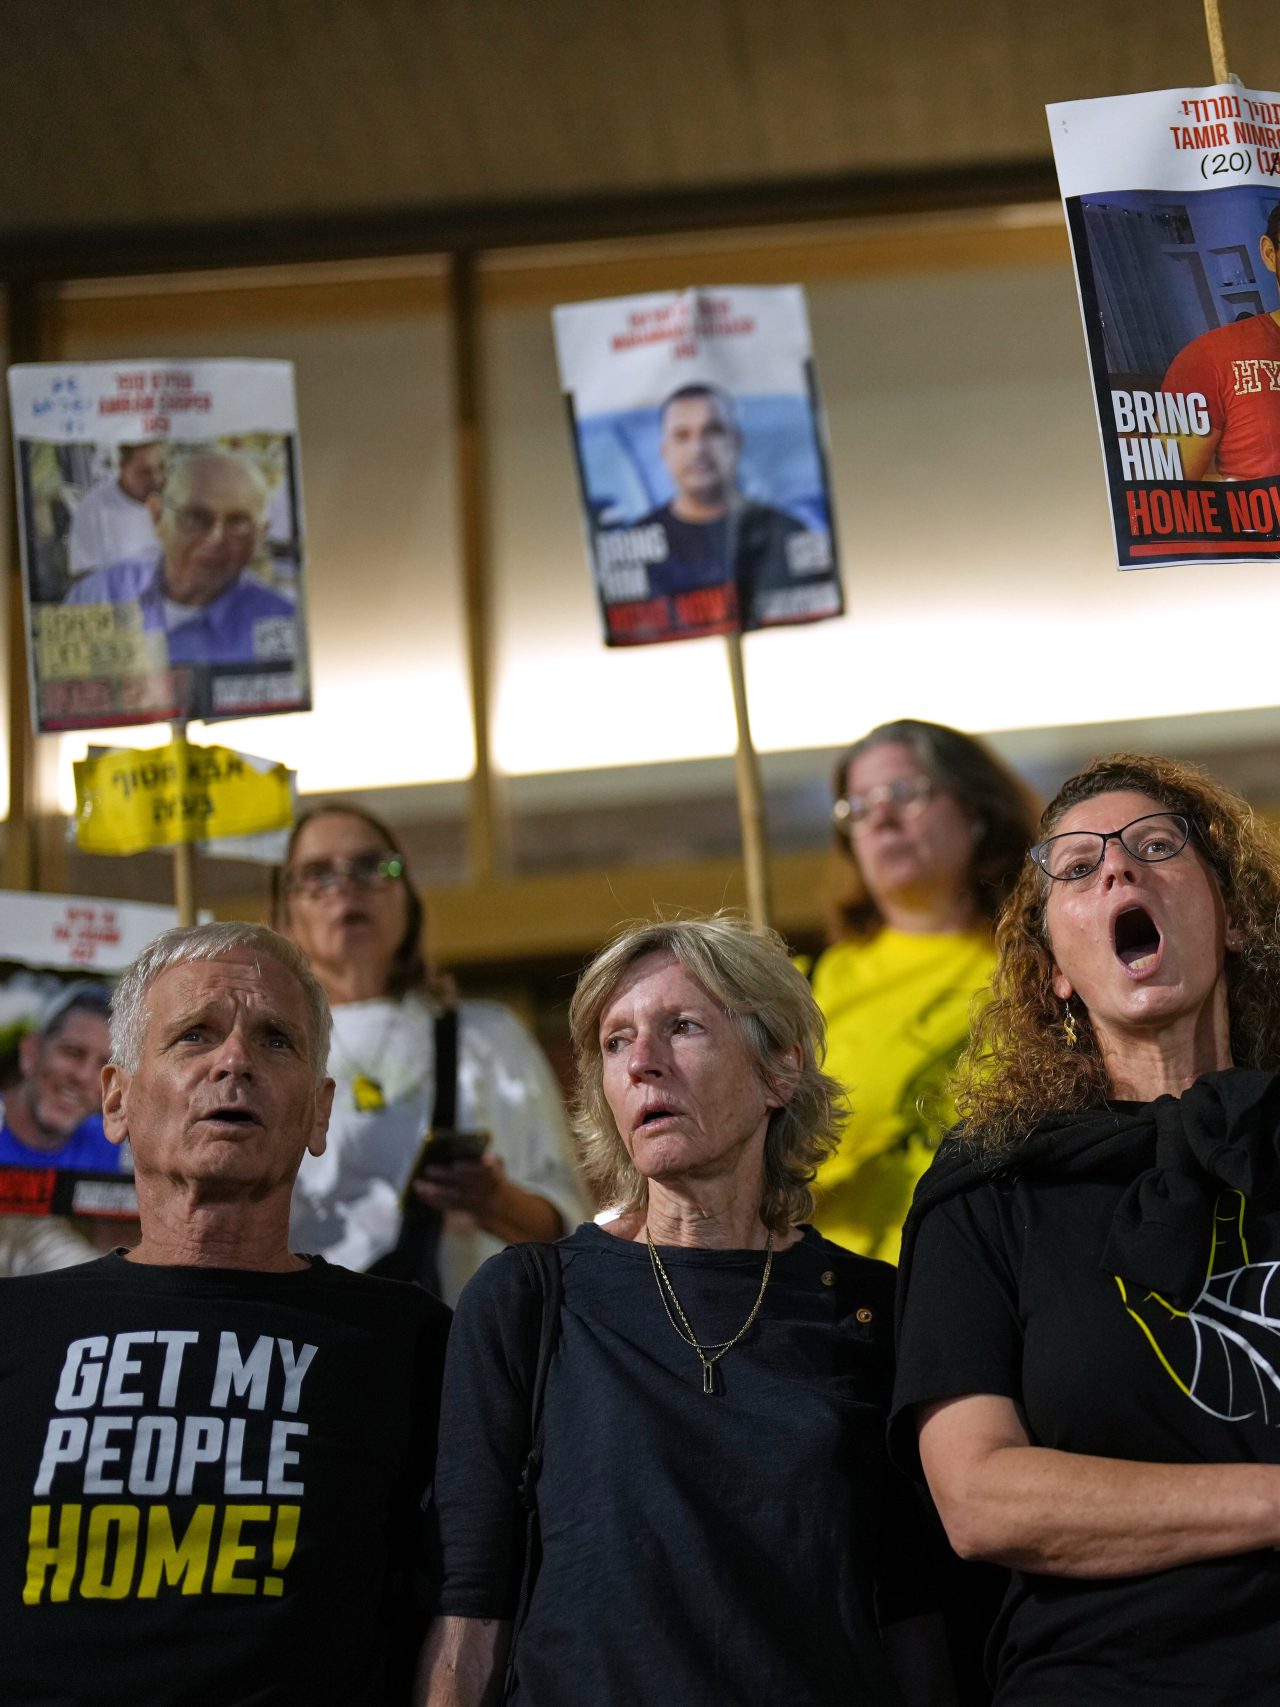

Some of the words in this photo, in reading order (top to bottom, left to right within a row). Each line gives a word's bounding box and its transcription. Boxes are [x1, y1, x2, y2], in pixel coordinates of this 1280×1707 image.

[1181, 95, 1241, 123] נמרודי
[1169, 123, 1230, 150] TAMIR
[1200, 150, 1252, 180] (20)
[1111, 390, 1211, 437] BRING
[1118, 437, 1184, 481] HIM
[1125, 489, 1224, 537] HOME
[54, 1330, 199, 1411] GET
[210, 1331, 319, 1414] MY
[33, 1416, 309, 1496] PEOPLE
[22, 1504, 301, 1605] HOME!
